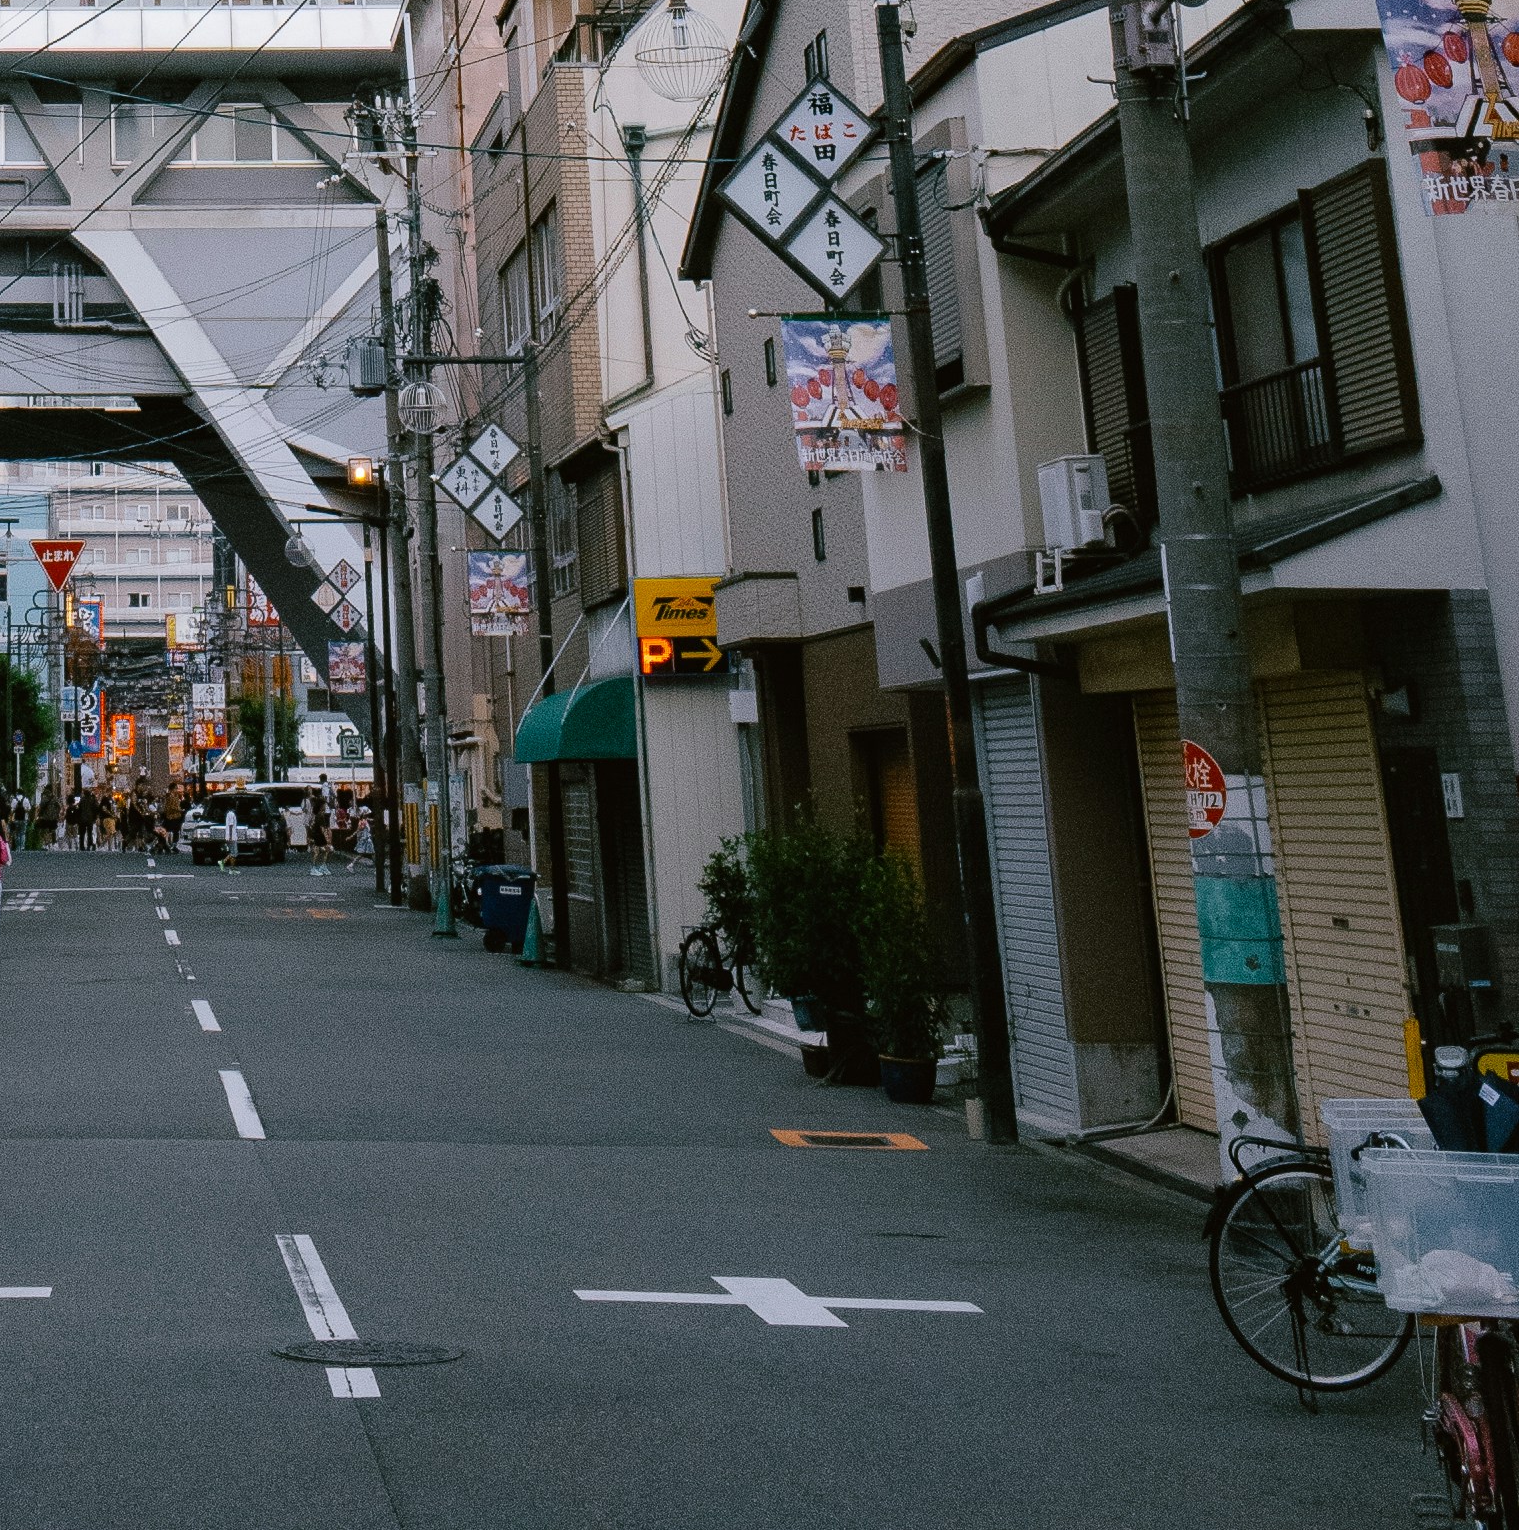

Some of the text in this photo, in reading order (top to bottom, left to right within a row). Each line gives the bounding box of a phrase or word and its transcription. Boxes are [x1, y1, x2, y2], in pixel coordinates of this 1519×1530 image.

[788, 121, 859, 142] たばこ
[760, 151, 783, 227] 春日町会
[822, 207, 848, 288] 春日町会
[41, 550, 76, 563] 止まれ
[652, 596, 714, 622] Times
[641, 637, 673, 675] P
[342, 737, 361, 747] TAXI
